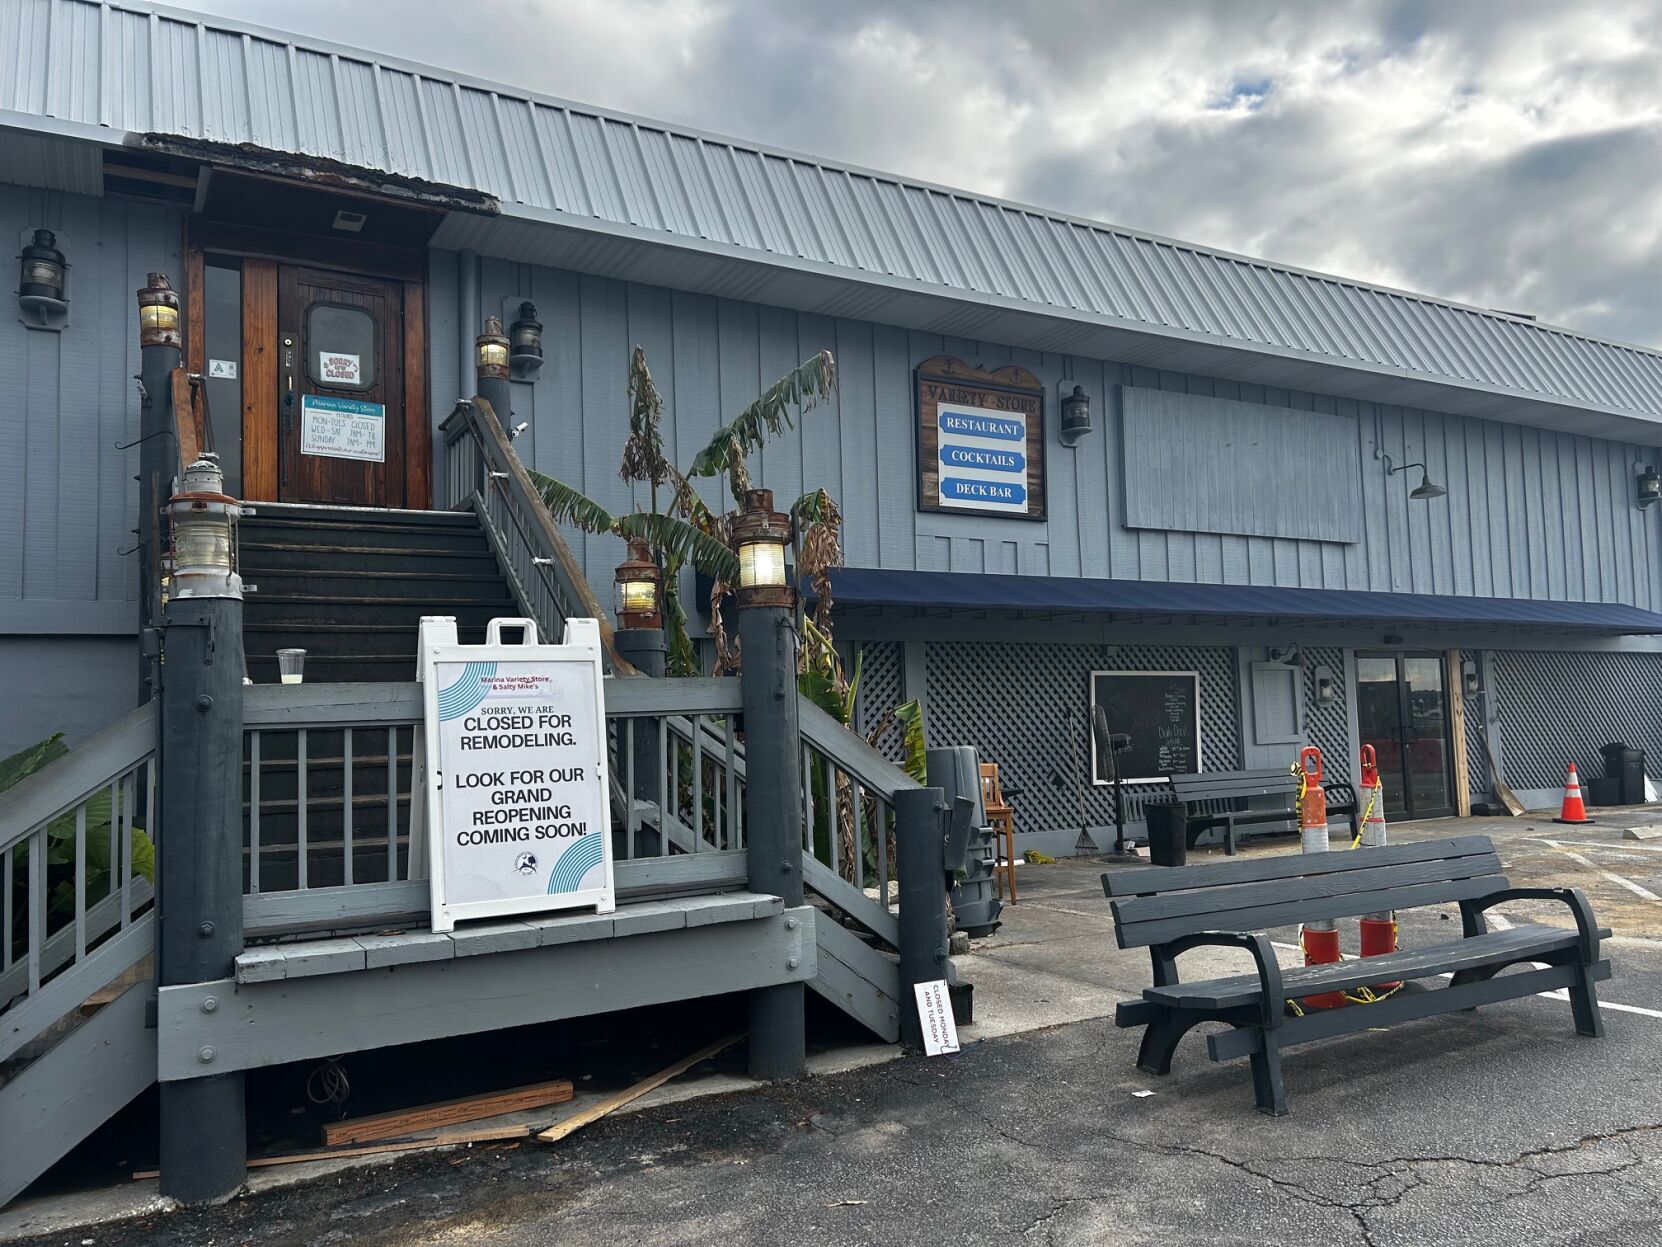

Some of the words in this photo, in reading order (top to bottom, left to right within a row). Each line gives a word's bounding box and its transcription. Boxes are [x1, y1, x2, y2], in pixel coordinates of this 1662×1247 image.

[928, 384, 985, 407] VARIETY
[996, 396, 1036, 413] STORE
[351, 421, 375, 431] CLOSED
[947, 417, 1018, 435] RESTAURANT
[311, 435, 335, 446] SUNDAY
[951, 450, 1015, 466] COCKTAILS
[956, 483, 988, 496] DECK
[990, 486, 1012, 498] BAR
[498, 683, 516, 691] Salty
[507, 676, 531, 684] Variety
[481, 706, 516, 716] SORRY,
[517, 706, 533, 714] WE
[535, 705, 554, 713] ARE
[463, 716, 533, 731] CLOSED
[539, 714, 572, 729] FOR
[460, 732, 577, 750] REMODELING.
[455, 772, 505, 788] LOOK
[510, 770, 544, 785] FOR
[549, 768, 584, 783] OUR
[491, 788, 552, 805] GRAND
[473, 805, 571, 826] REOPENING
[457, 827, 530, 846] COMING
[535, 822, 587, 840] SOON!
[924, 991, 932, 1008] AND
[928, 1010, 939, 1043] TUESDAY
[933, 984, 944, 1014] CLOSED
[939, 1016, 950, 1047] MONDAY
